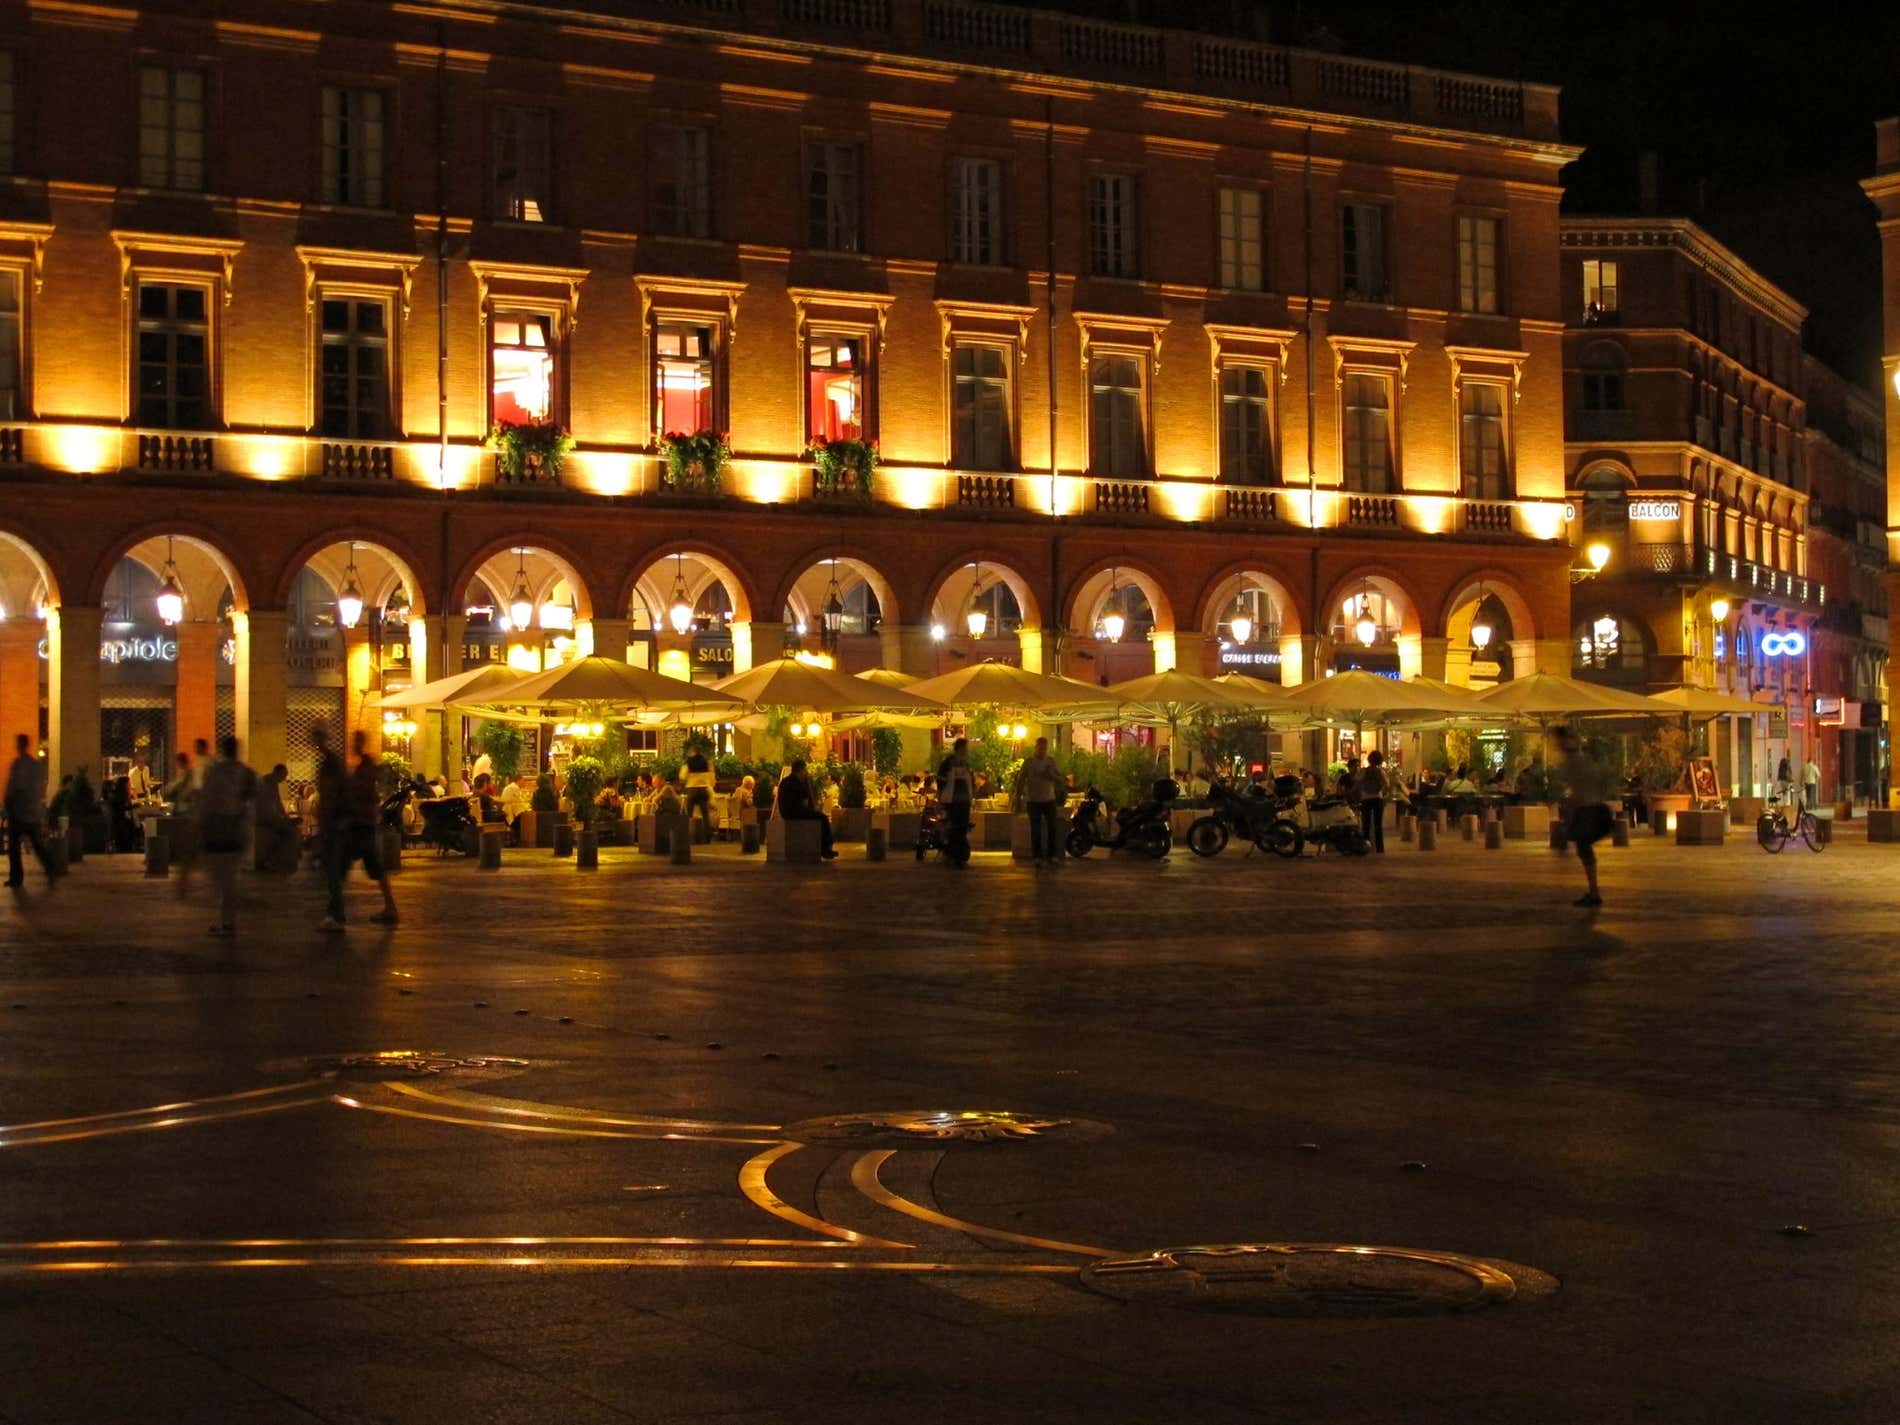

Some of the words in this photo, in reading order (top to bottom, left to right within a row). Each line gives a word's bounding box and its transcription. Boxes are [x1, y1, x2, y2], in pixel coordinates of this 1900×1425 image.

[1631, 504, 1679, 517] BALCON
[100, 635, 177, 663] apitole
[699, 647, 733, 662] SALO
